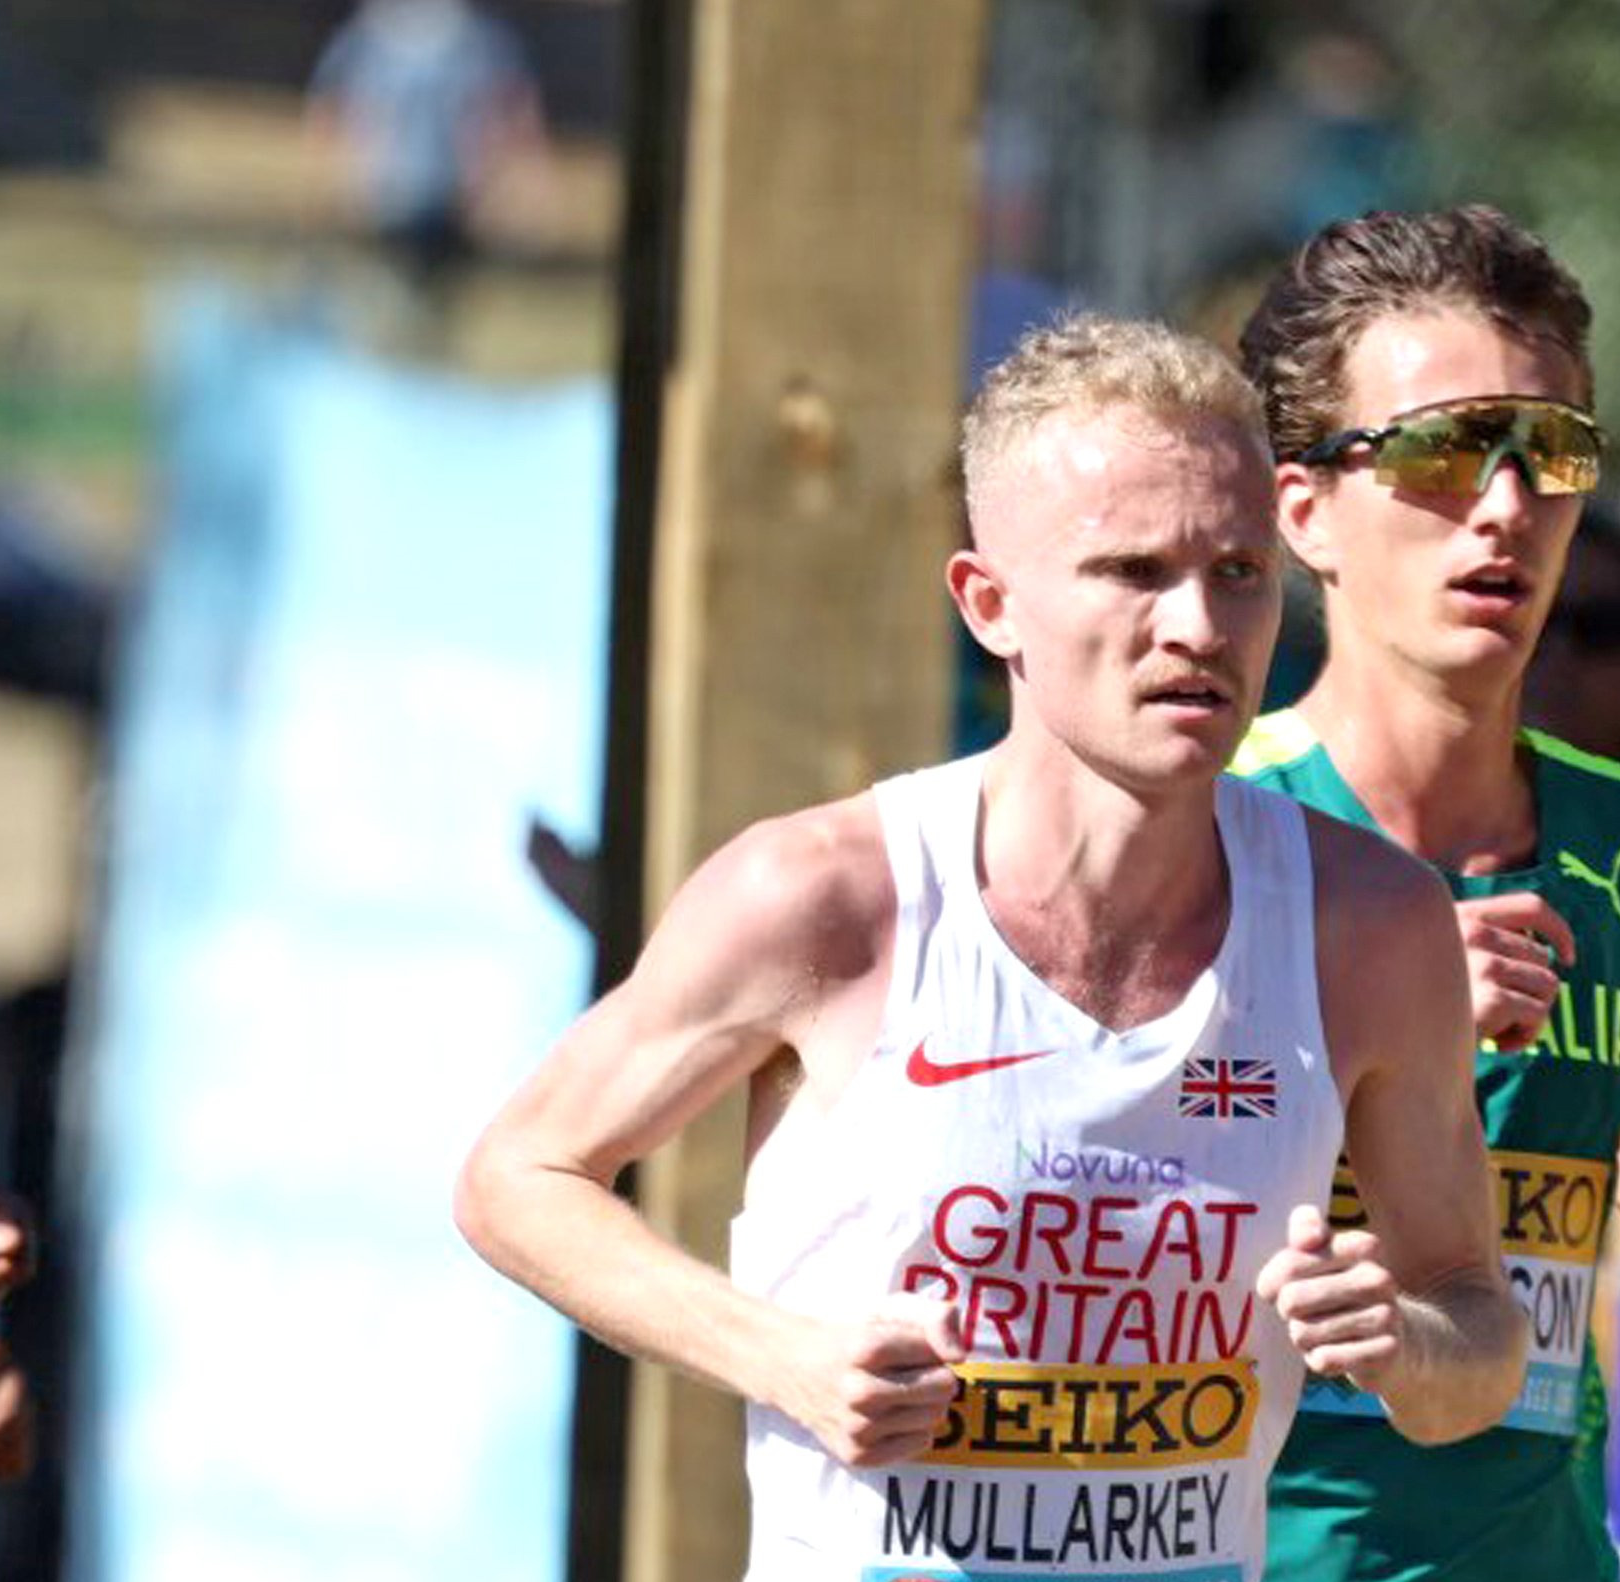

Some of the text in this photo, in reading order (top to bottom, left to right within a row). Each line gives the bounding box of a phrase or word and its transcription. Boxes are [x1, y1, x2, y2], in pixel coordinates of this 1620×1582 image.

[1016, 1138, 1187, 1187] Novuna
[932, 1184, 1259, 1283] GREAT
[883, 1471, 1229, 1564] MULLARKEY
